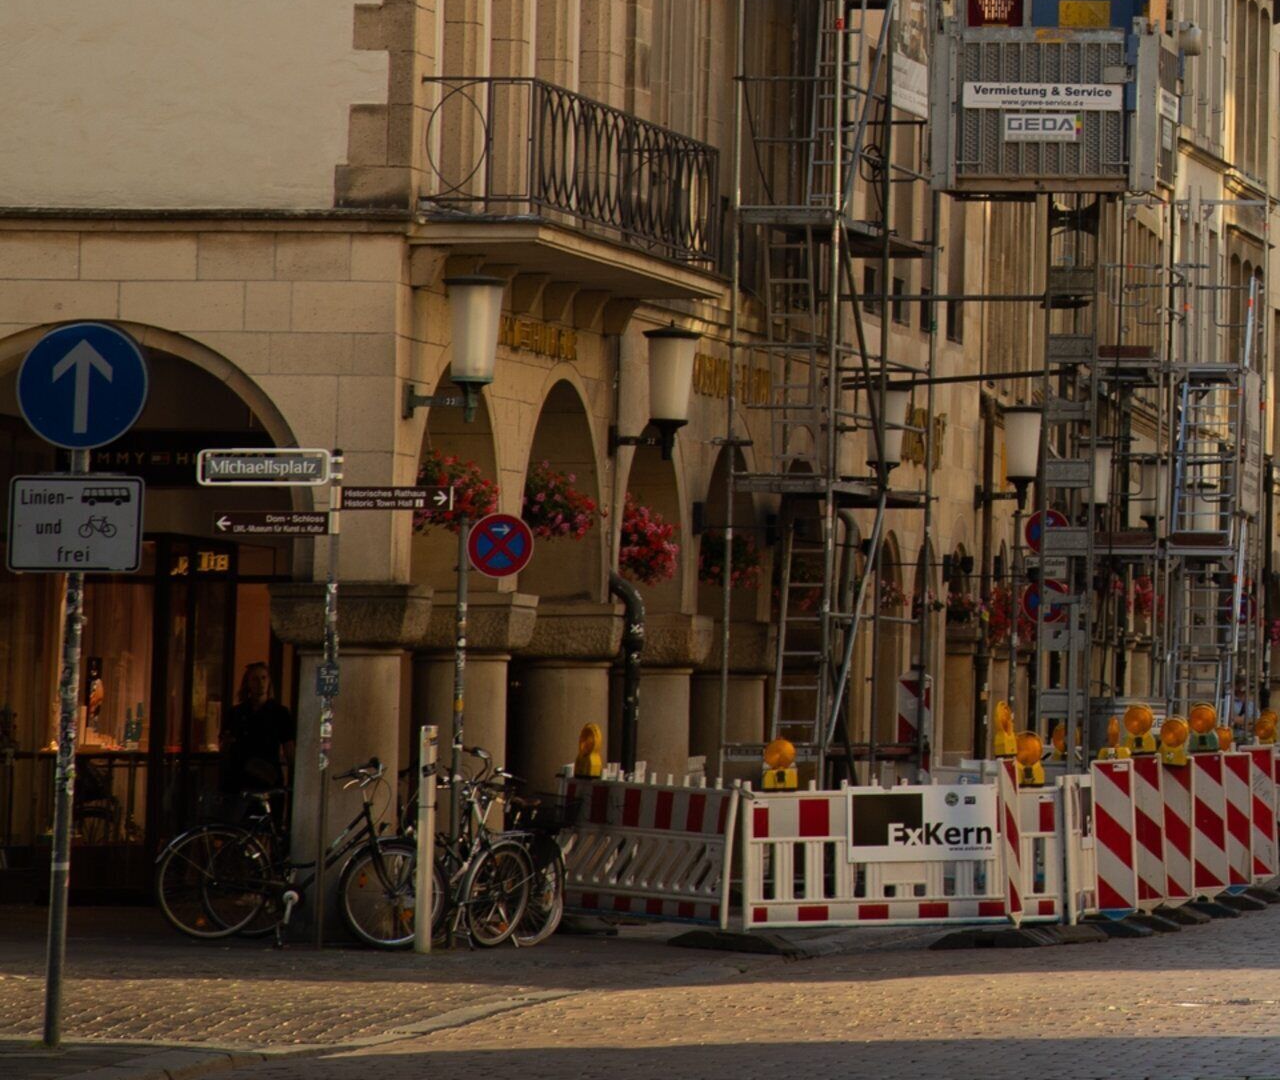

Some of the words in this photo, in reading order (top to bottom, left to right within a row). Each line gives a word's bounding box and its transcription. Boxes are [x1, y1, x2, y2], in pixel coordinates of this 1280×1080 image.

[973, 85, 1047, 98] Vermietung
[1051, 86, 1060, 96] &
[1065, 86, 1112, 97] Service
[1007, 118, 1074, 131] GEDA
[209, 459, 316, 476] Michaelisplatz
[21, 488, 74, 505] Linien-
[344, 489, 393, 497] Historisches
[394, 489, 427, 497] Rathaus
[344, 499, 374, 508] Historic
[376, 499, 396, 508] Town
[398, 499, 413, 508] Hall
[265, 514, 285, 523] Dom
[292, 514, 325, 523] Schloss
[36, 518, 62, 535] und
[57, 545, 90, 562] frei
[888, 822, 992, 846] ExKern
